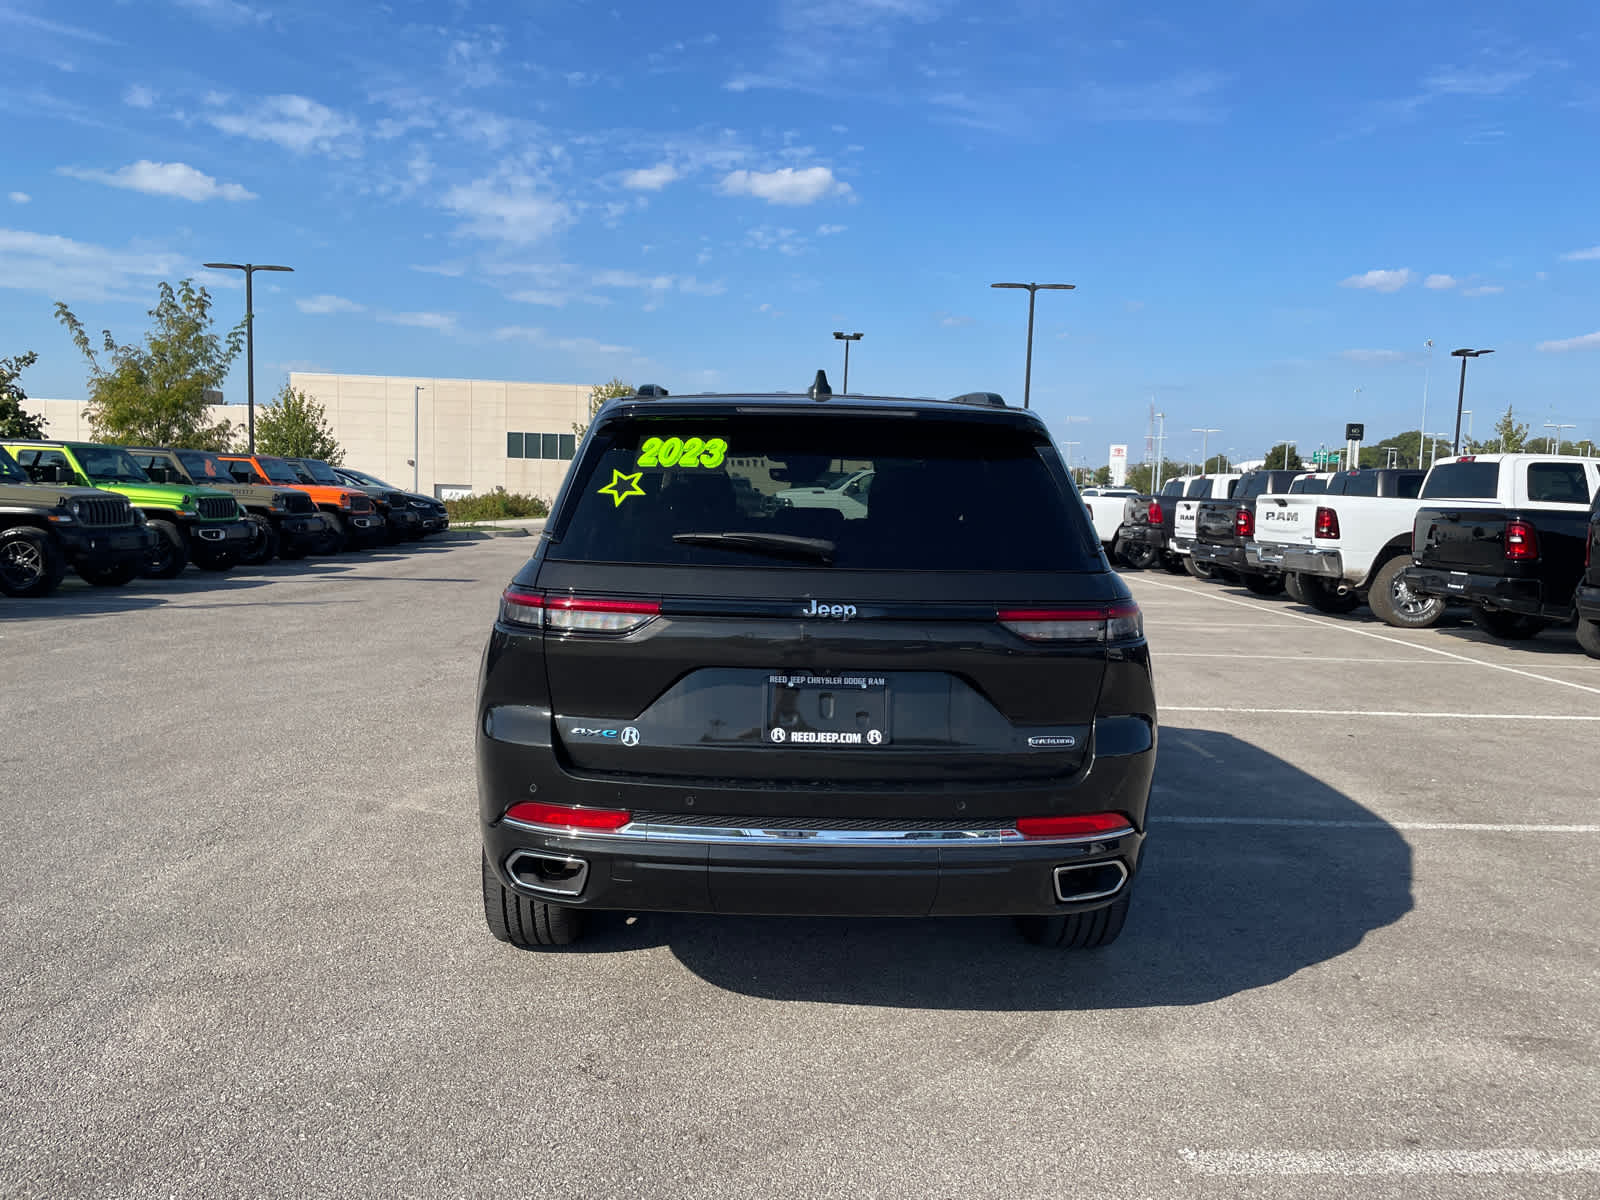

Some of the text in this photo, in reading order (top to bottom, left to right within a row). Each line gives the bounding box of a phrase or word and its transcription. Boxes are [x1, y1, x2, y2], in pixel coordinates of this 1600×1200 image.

[637, 437, 728, 468] 2023
[1265, 511, 1299, 521] RAM
[802, 599, 857, 621] Jeep
[769, 675, 787, 683] REED
[790, 676, 806, 684] JEEP
[807, 676, 842, 685] CHRYSLER
[868, 677, 885, 685] RAM
[791, 732, 861, 743] REEDJEEP.COM
